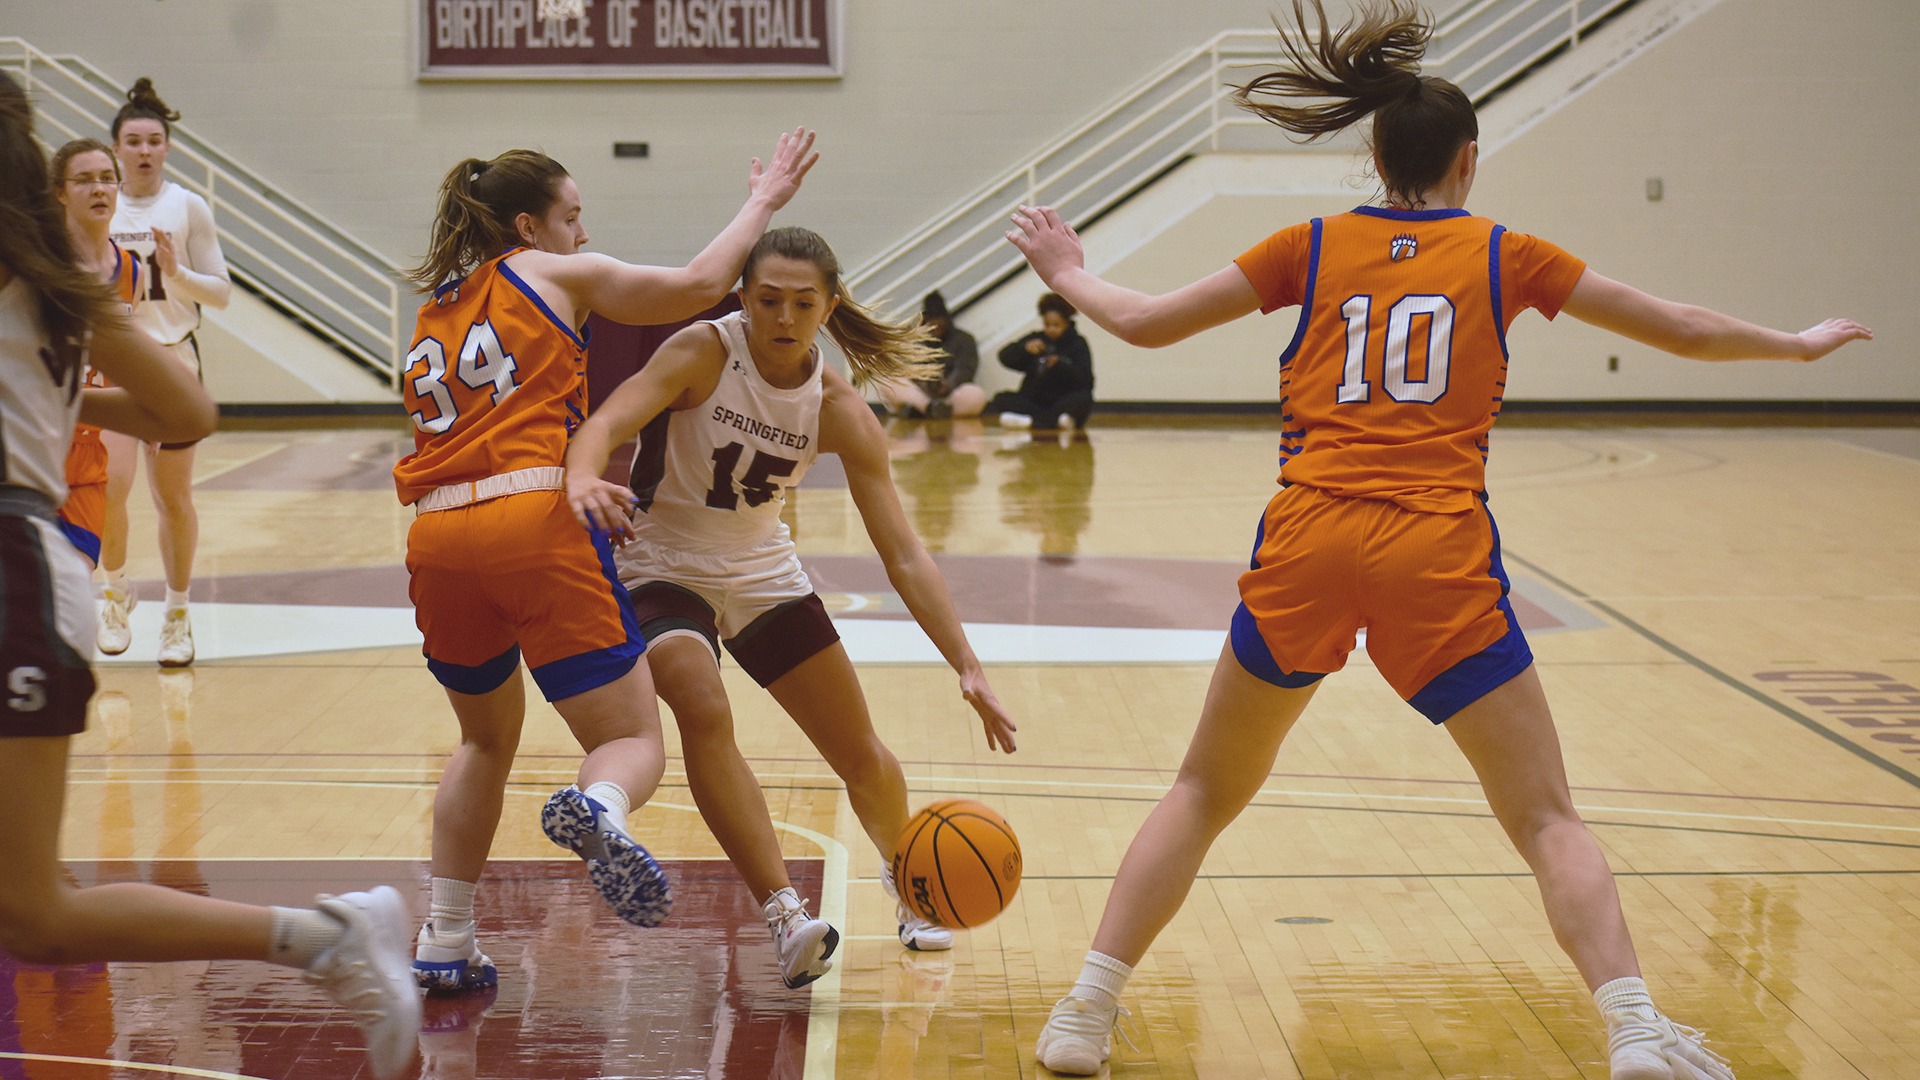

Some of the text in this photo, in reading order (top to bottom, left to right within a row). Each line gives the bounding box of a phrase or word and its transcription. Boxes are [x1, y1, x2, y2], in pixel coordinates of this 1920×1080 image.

[436, 0, 821, 48] BIRTHPLACE OF BASKETBALL
[404, 316, 522, 437] 34
[1336, 293, 1456, 405] 10
[705, 441, 799, 511] 15
[7, 666, 47, 712] S
